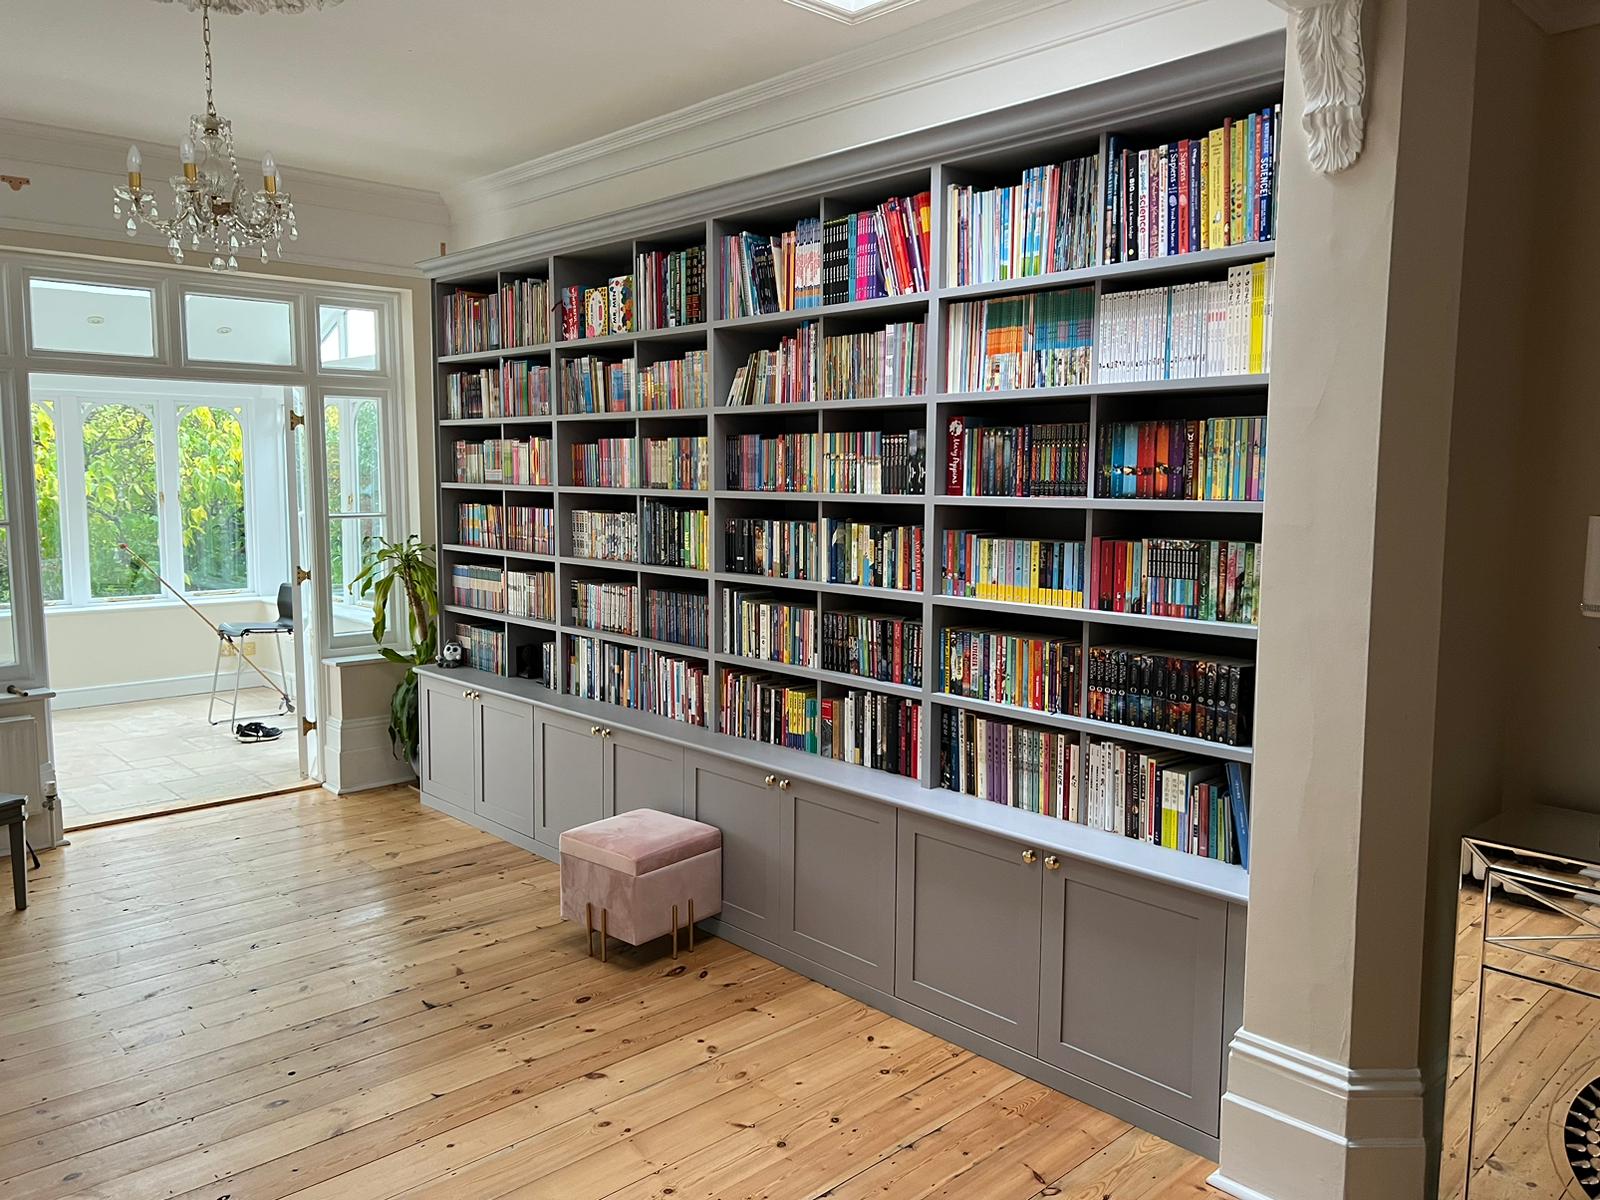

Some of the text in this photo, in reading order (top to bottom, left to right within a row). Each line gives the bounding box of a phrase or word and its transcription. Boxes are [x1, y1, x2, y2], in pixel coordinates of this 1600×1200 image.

[1169, 154, 1177, 182] Sapiens
[1179, 152, 1187, 181] Sapiens
[1260, 157, 1269, 197] SCIENCE!
[1139, 194, 1147, 233] science
[949, 457, 961, 484] Poppins
